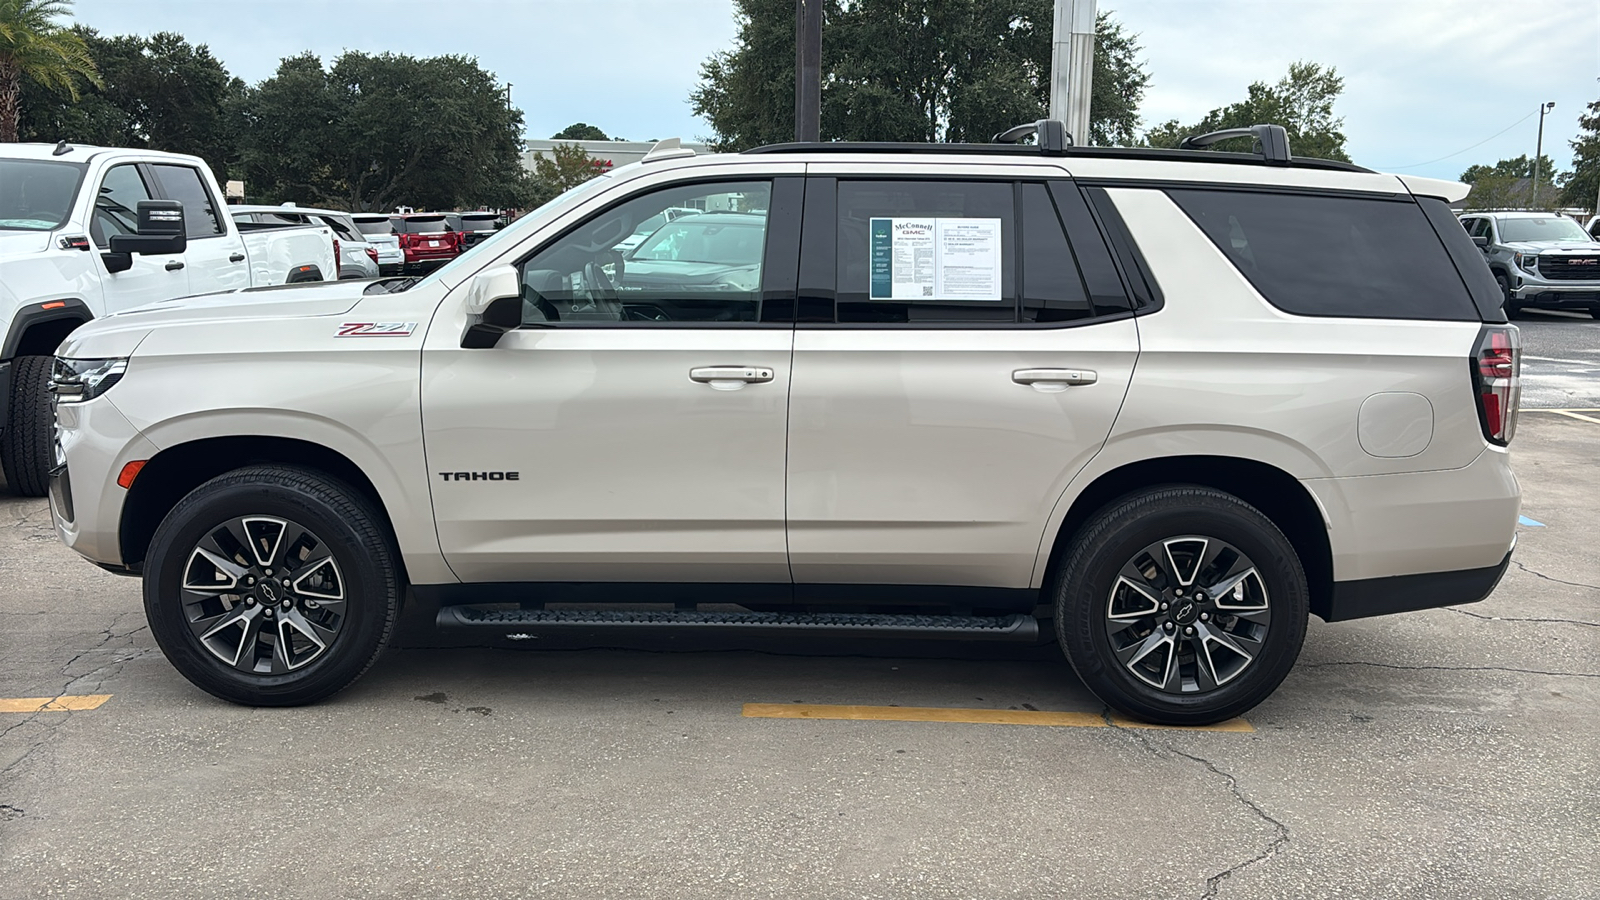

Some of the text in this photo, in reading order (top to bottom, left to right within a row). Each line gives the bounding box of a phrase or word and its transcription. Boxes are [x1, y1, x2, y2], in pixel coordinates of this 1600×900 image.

[895, 222, 933, 231] McConnell
[334, 322, 417, 338] Z71
[438, 471, 520, 481] TAHOE
